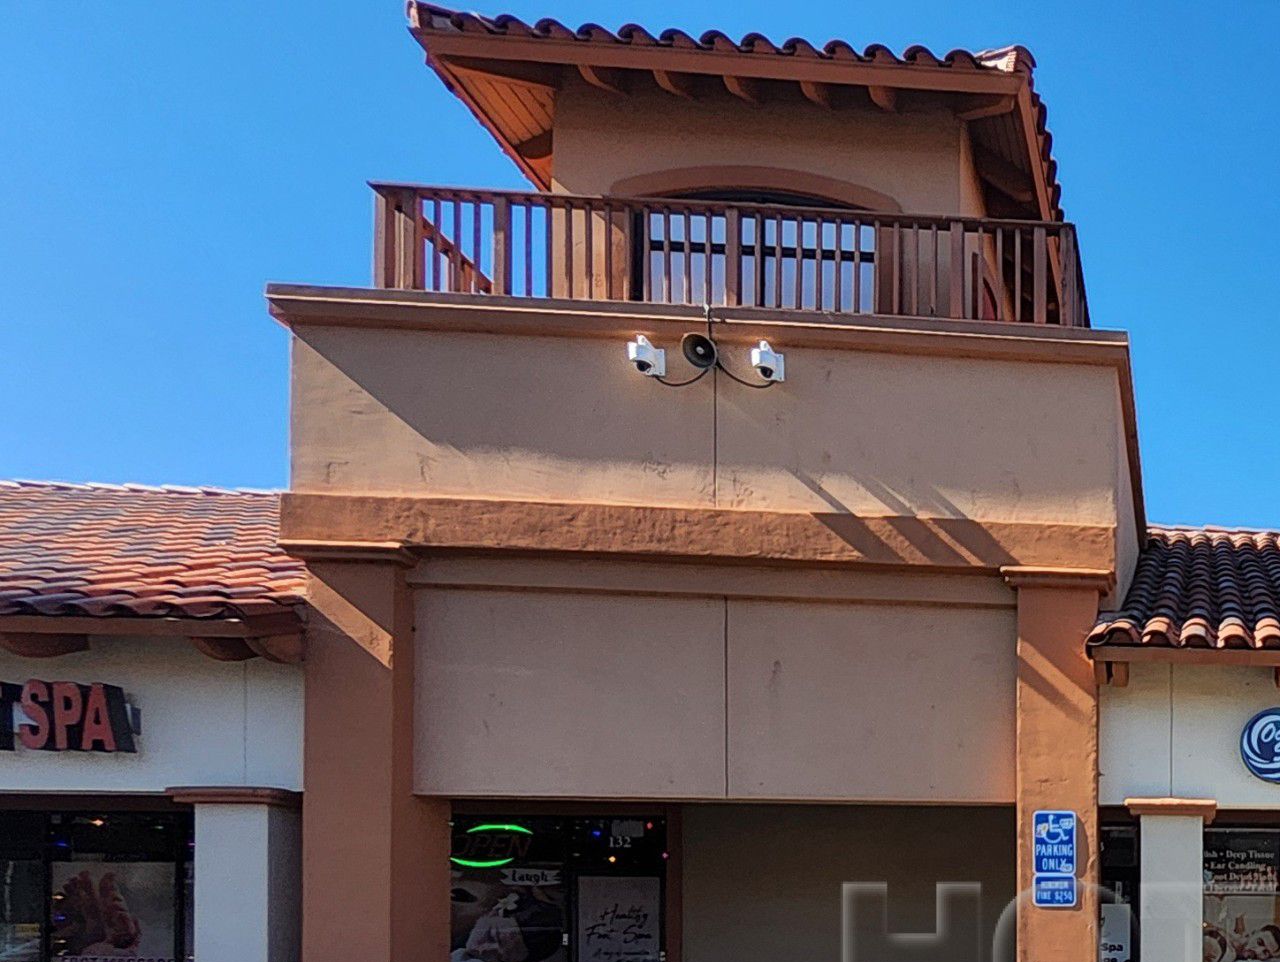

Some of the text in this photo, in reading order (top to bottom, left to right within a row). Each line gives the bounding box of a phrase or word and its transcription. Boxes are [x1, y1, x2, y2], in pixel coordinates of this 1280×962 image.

[18, 679, 118, 751] SPA
[608, 836, 632, 848] 132
[1036, 843, 1073, 857] PARKING
[1225, 850, 1247, 860] Deep
